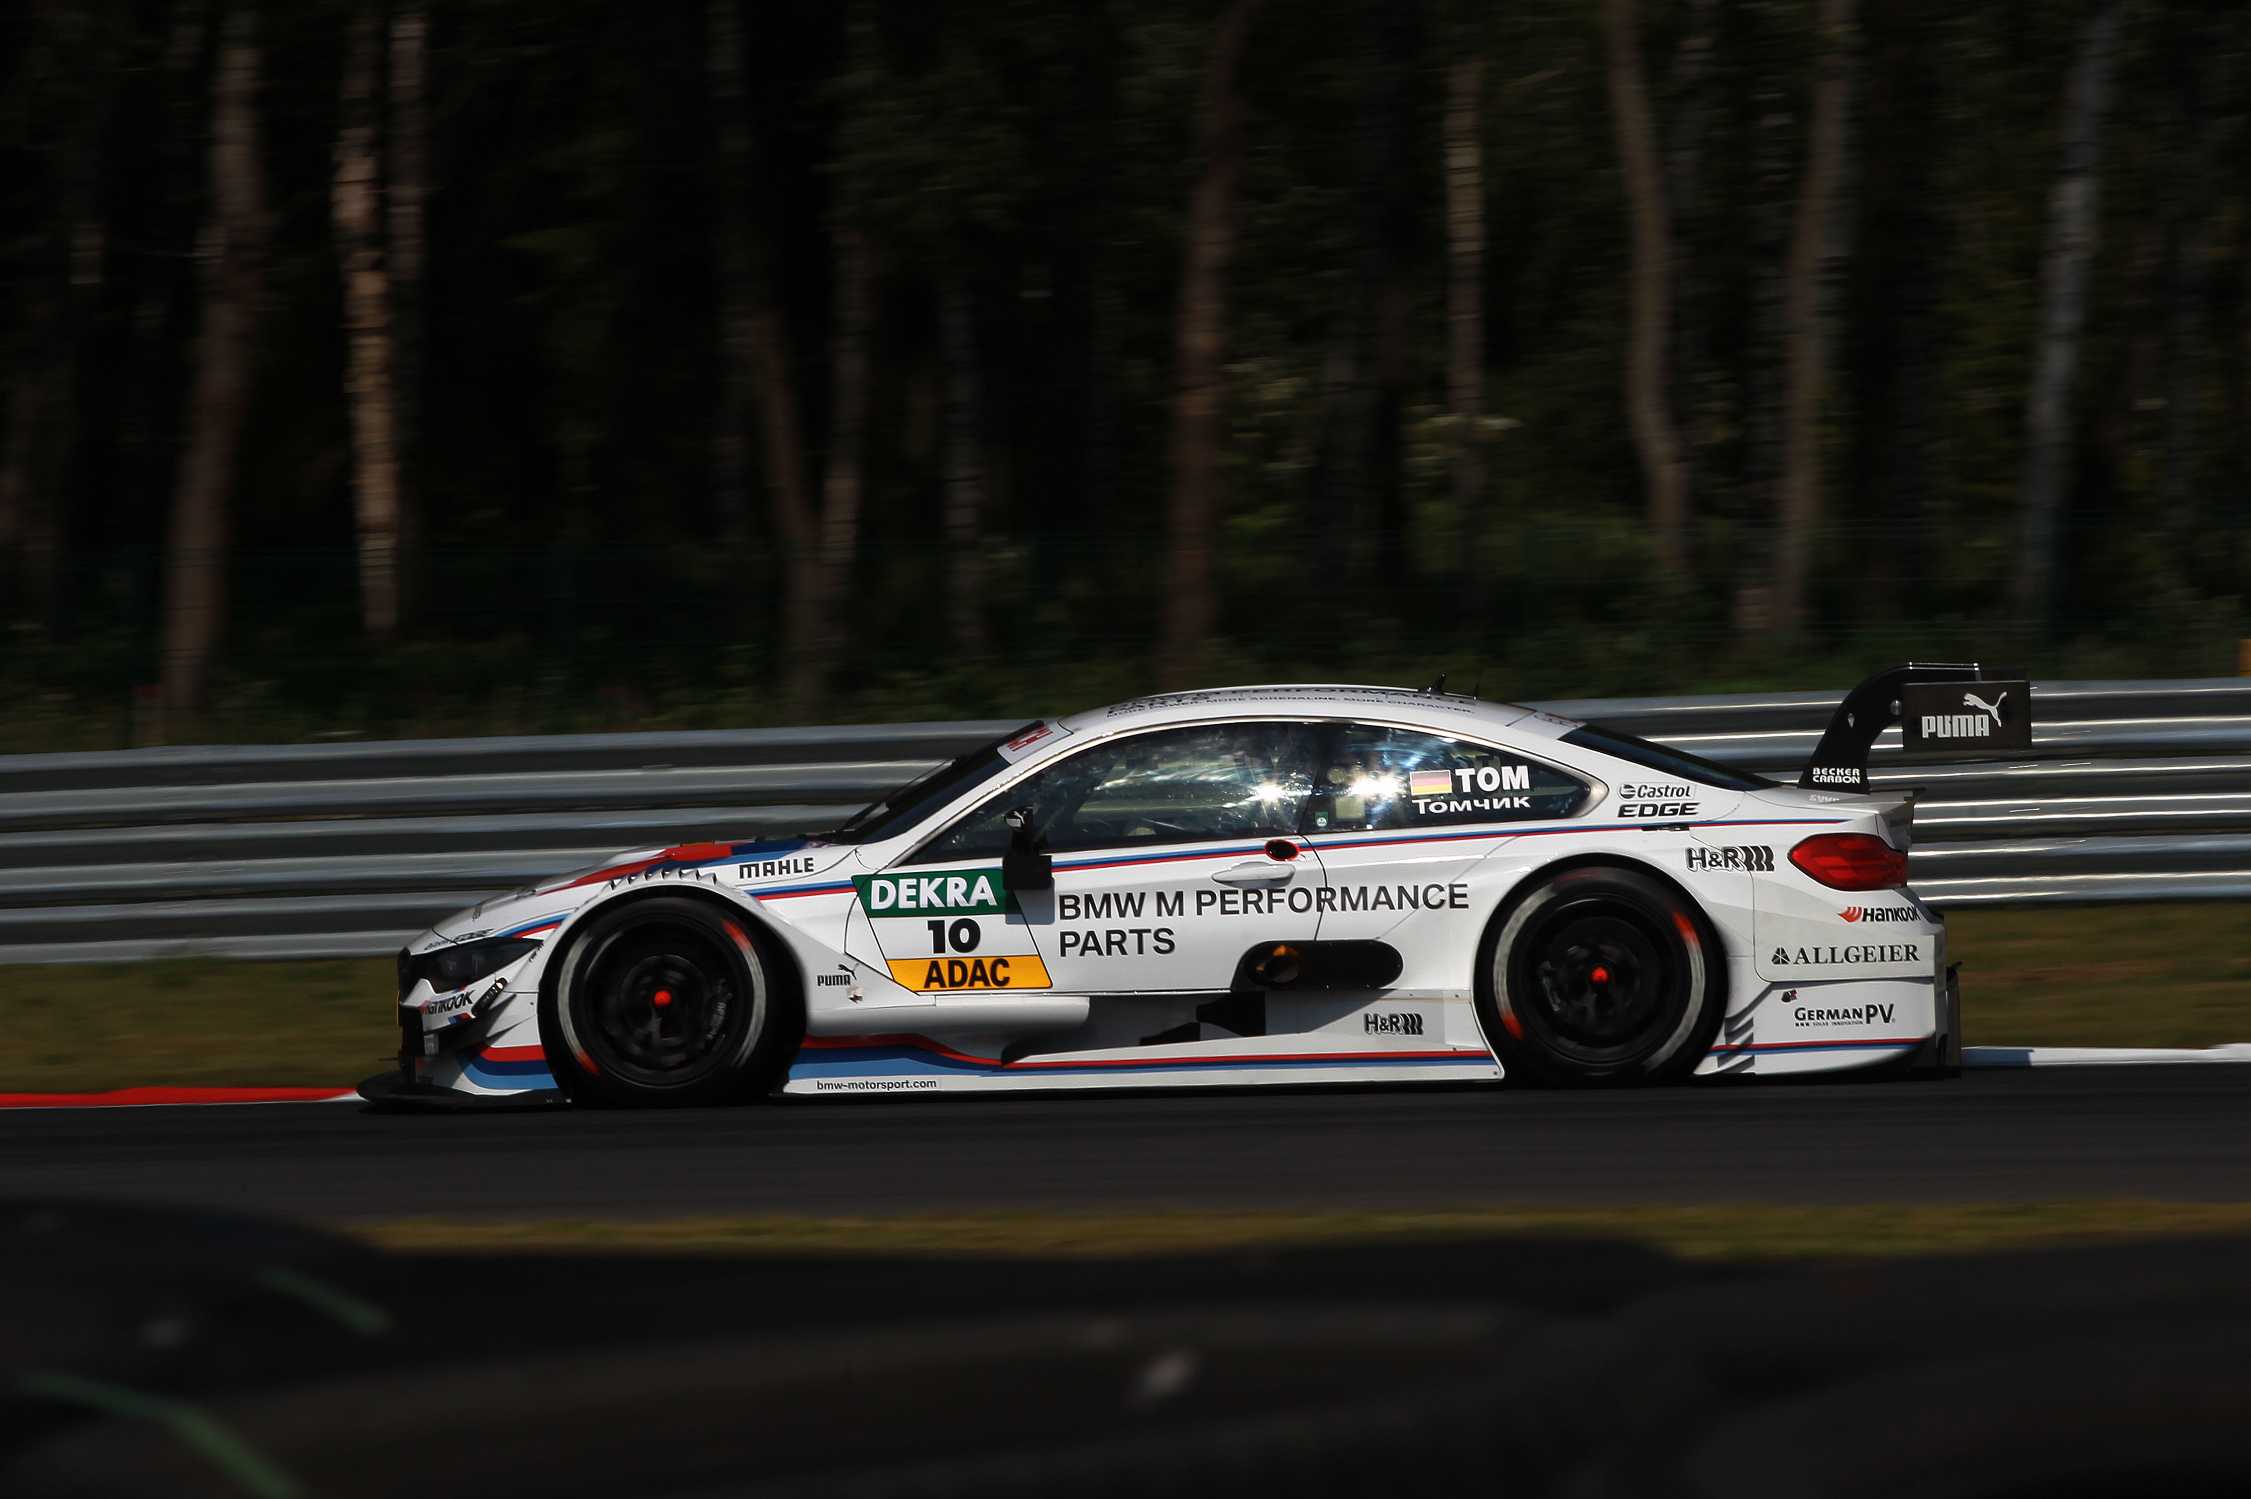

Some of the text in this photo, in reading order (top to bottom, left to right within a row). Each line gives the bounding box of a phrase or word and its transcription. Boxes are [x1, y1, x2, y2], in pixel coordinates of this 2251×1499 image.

[1922, 714, 1990, 738] PUMA
[1455, 765, 1530, 793] TOM
[1812, 767, 1861, 776] BECKER
[1812, 775, 1861, 784] CARBON
[1636, 783, 1692, 799] Castrol
[1617, 802, 1701, 818] EDGE
[739, 857, 815, 879] MAHLE
[1687, 847, 1744, 872] H&R
[870, 875, 998, 910] DEKRA
[1059, 883, 1470, 921] BMW M PERFORMANCE
[927, 918, 981, 954] 10
[1059, 928, 1176, 958] PARTS
[1794, 944, 1921, 966] ALLGEIER
[817, 974, 851, 987] PUMA
[924, 959, 1011, 989] ADAC
[1364, 1013, 1402, 1035] H&R
[816, 1078, 937, 1091] bmw-motorsport.com
